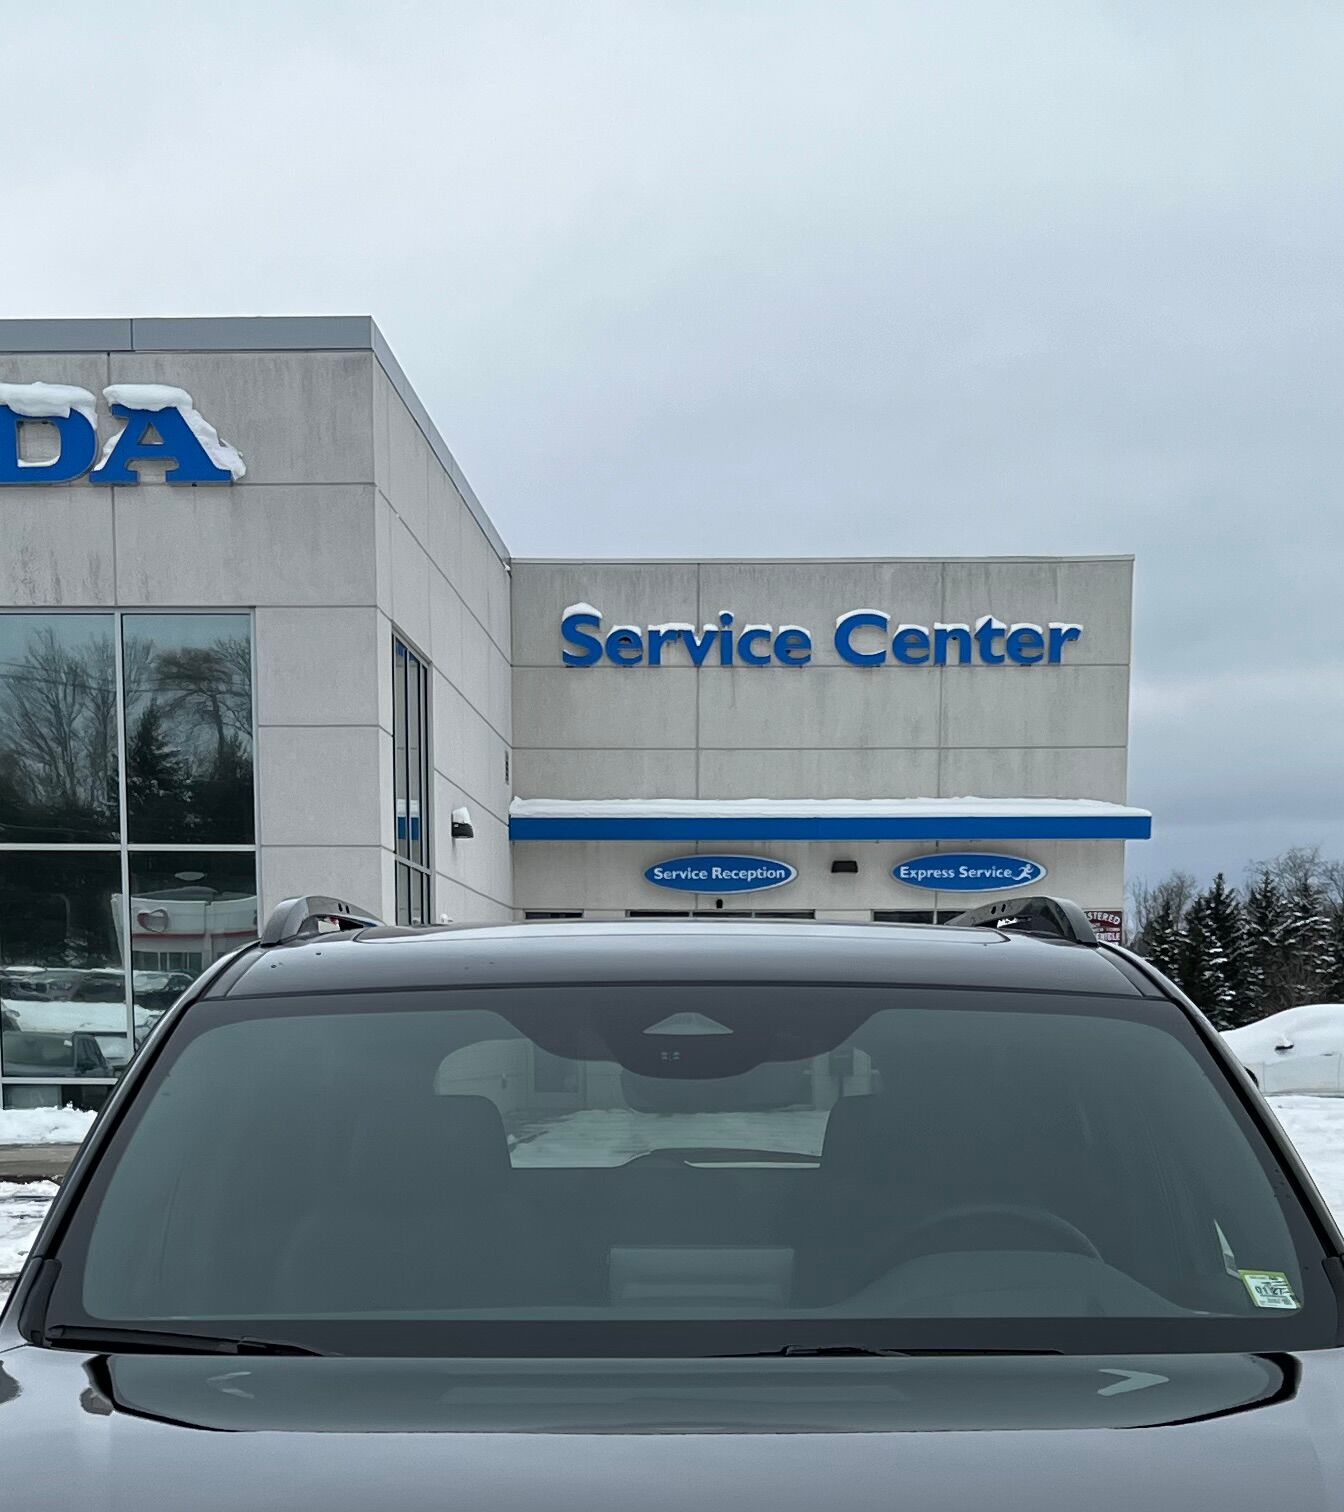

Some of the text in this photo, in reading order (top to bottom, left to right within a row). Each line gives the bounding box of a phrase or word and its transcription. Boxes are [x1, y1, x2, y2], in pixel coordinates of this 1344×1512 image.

[560, 611, 1083, 667] Service Center
[653, 866, 786, 882] Service Reception
[899, 865, 1013, 882] Express Service
[1087, 911, 1120, 924] STERED
